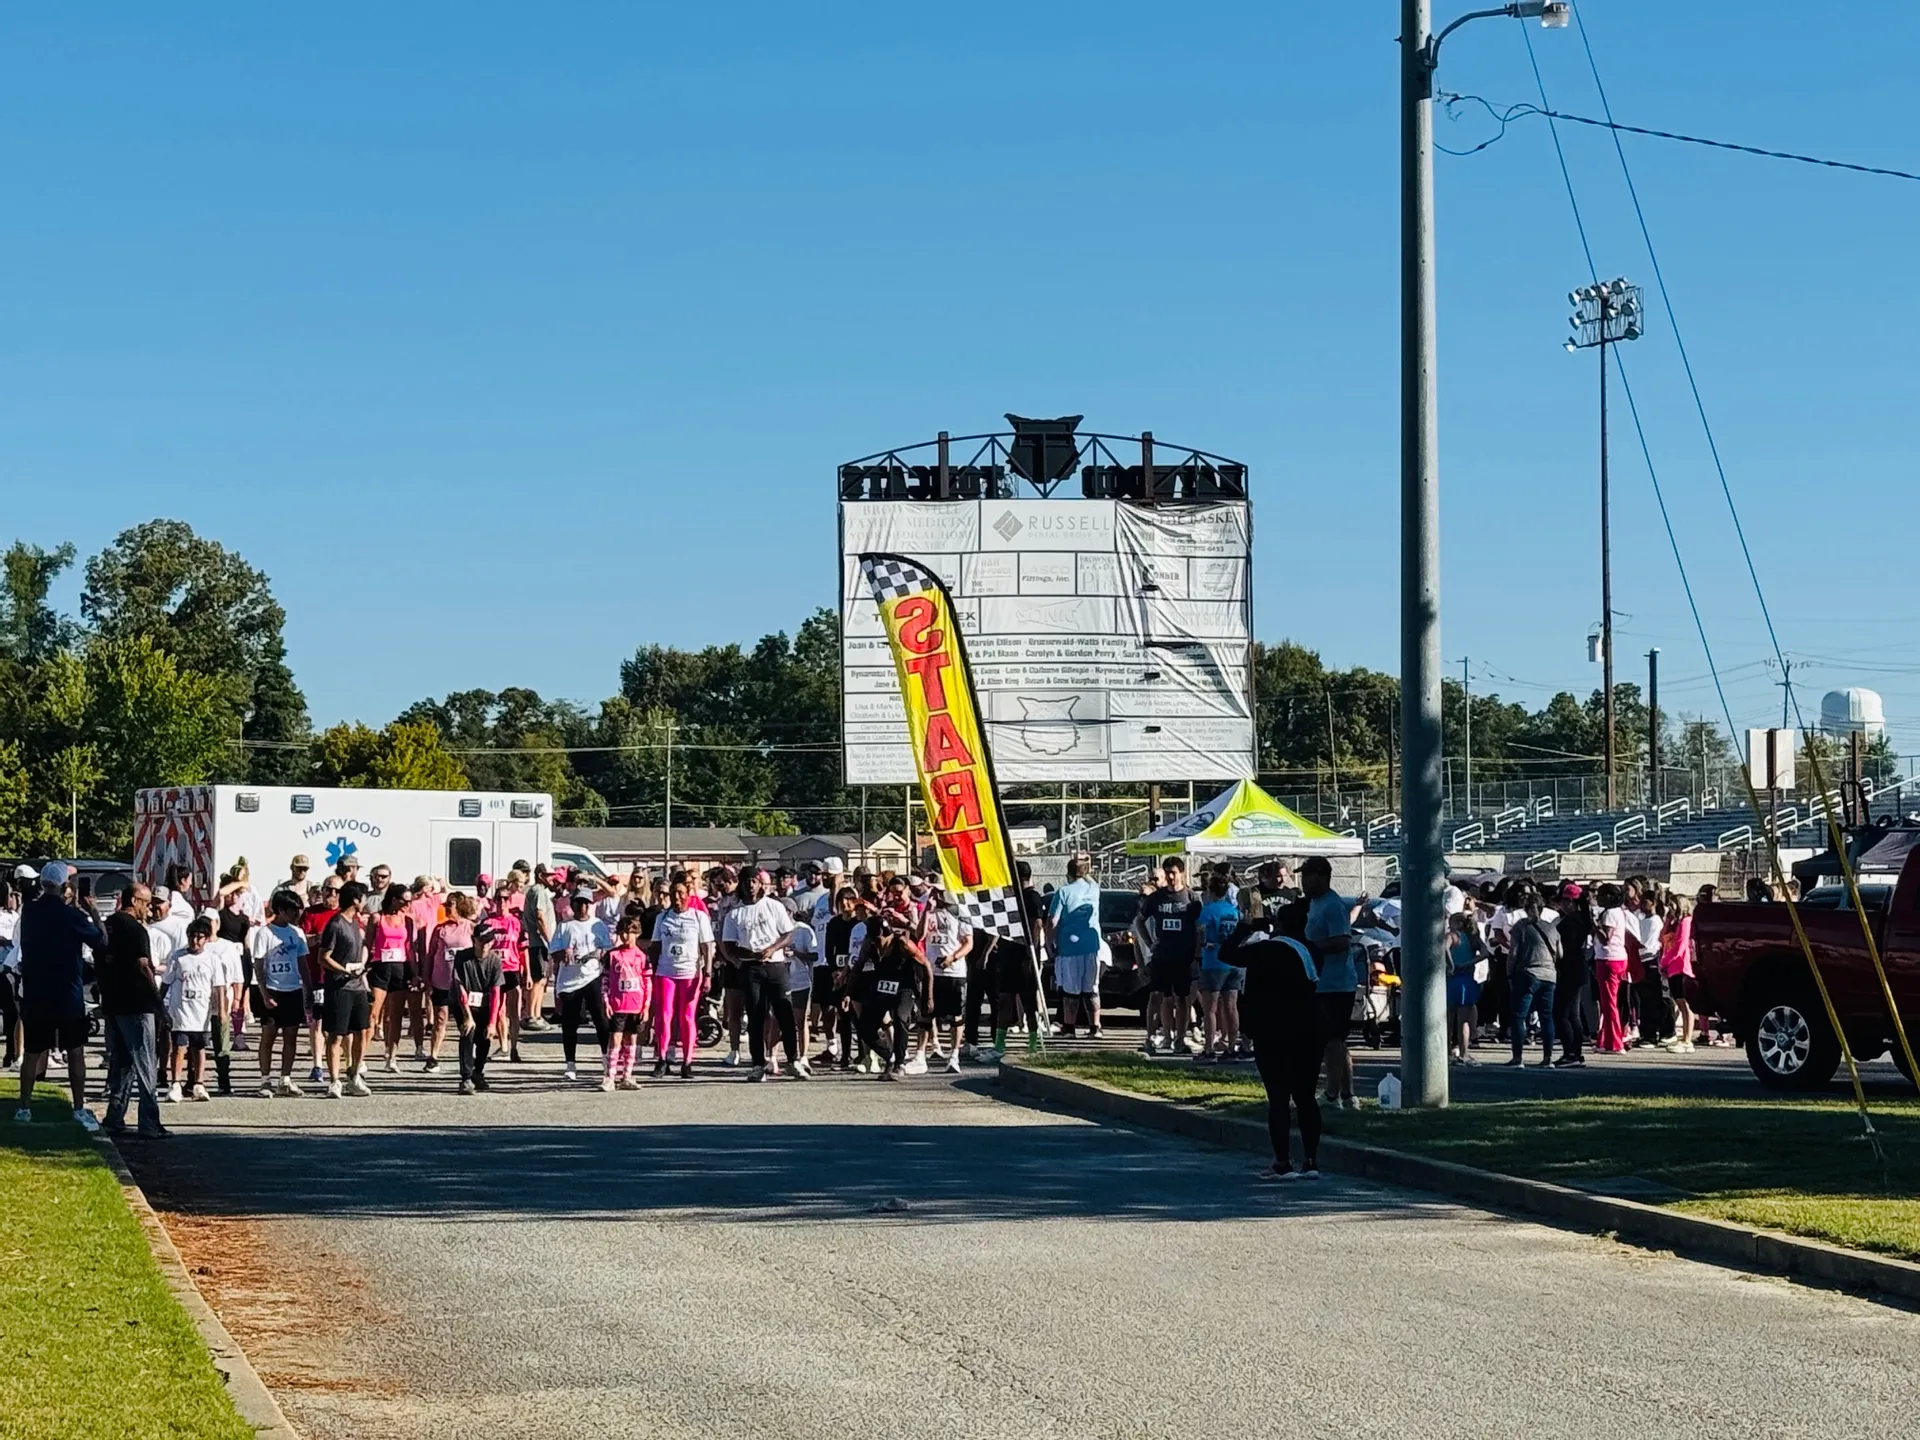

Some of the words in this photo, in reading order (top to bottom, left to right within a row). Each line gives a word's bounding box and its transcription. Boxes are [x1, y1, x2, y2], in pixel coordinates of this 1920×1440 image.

[1028, 516, 1112, 531] RUSSELL
[1021, 565, 1072, 575] LASCO
[1026, 649, 1056, 659] Carolyn
[1057, 649, 1063, 657] &
[1064, 649, 1094, 658] Gordon
[302, 818, 381, 839] HAYWOOD
[932, 935, 949, 945] 123
[671, 946, 684, 956] 43
[271, 962, 292, 974] 125
[880, 981, 897, 992] 121
[184, 989, 203, 1000] 122
